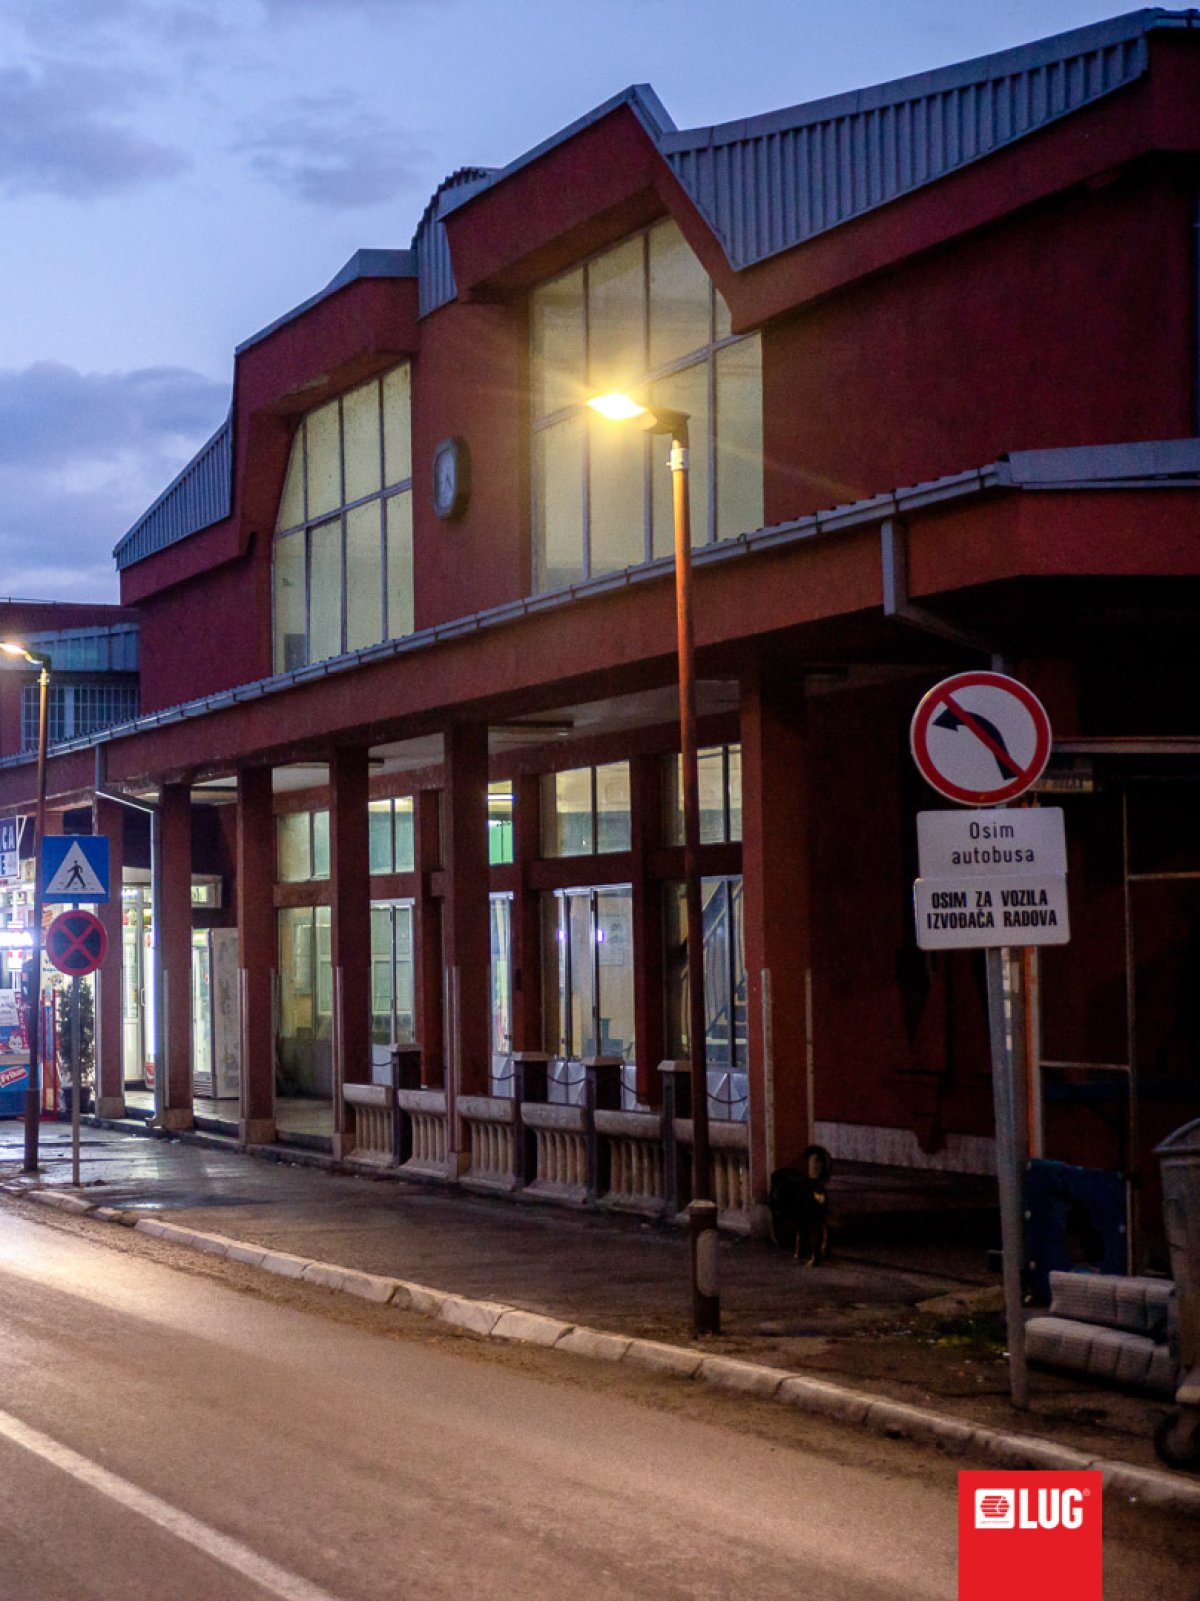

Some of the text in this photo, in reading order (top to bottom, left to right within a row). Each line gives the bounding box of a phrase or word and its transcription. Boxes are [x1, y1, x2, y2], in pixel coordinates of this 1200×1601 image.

[969, 821, 1014, 839] Osim
[951, 845, 1035, 865] autobusa
[931, 889, 1048, 909] OSIM ZA VOZILA
[1003, 909, 1058, 928] RADOVA
